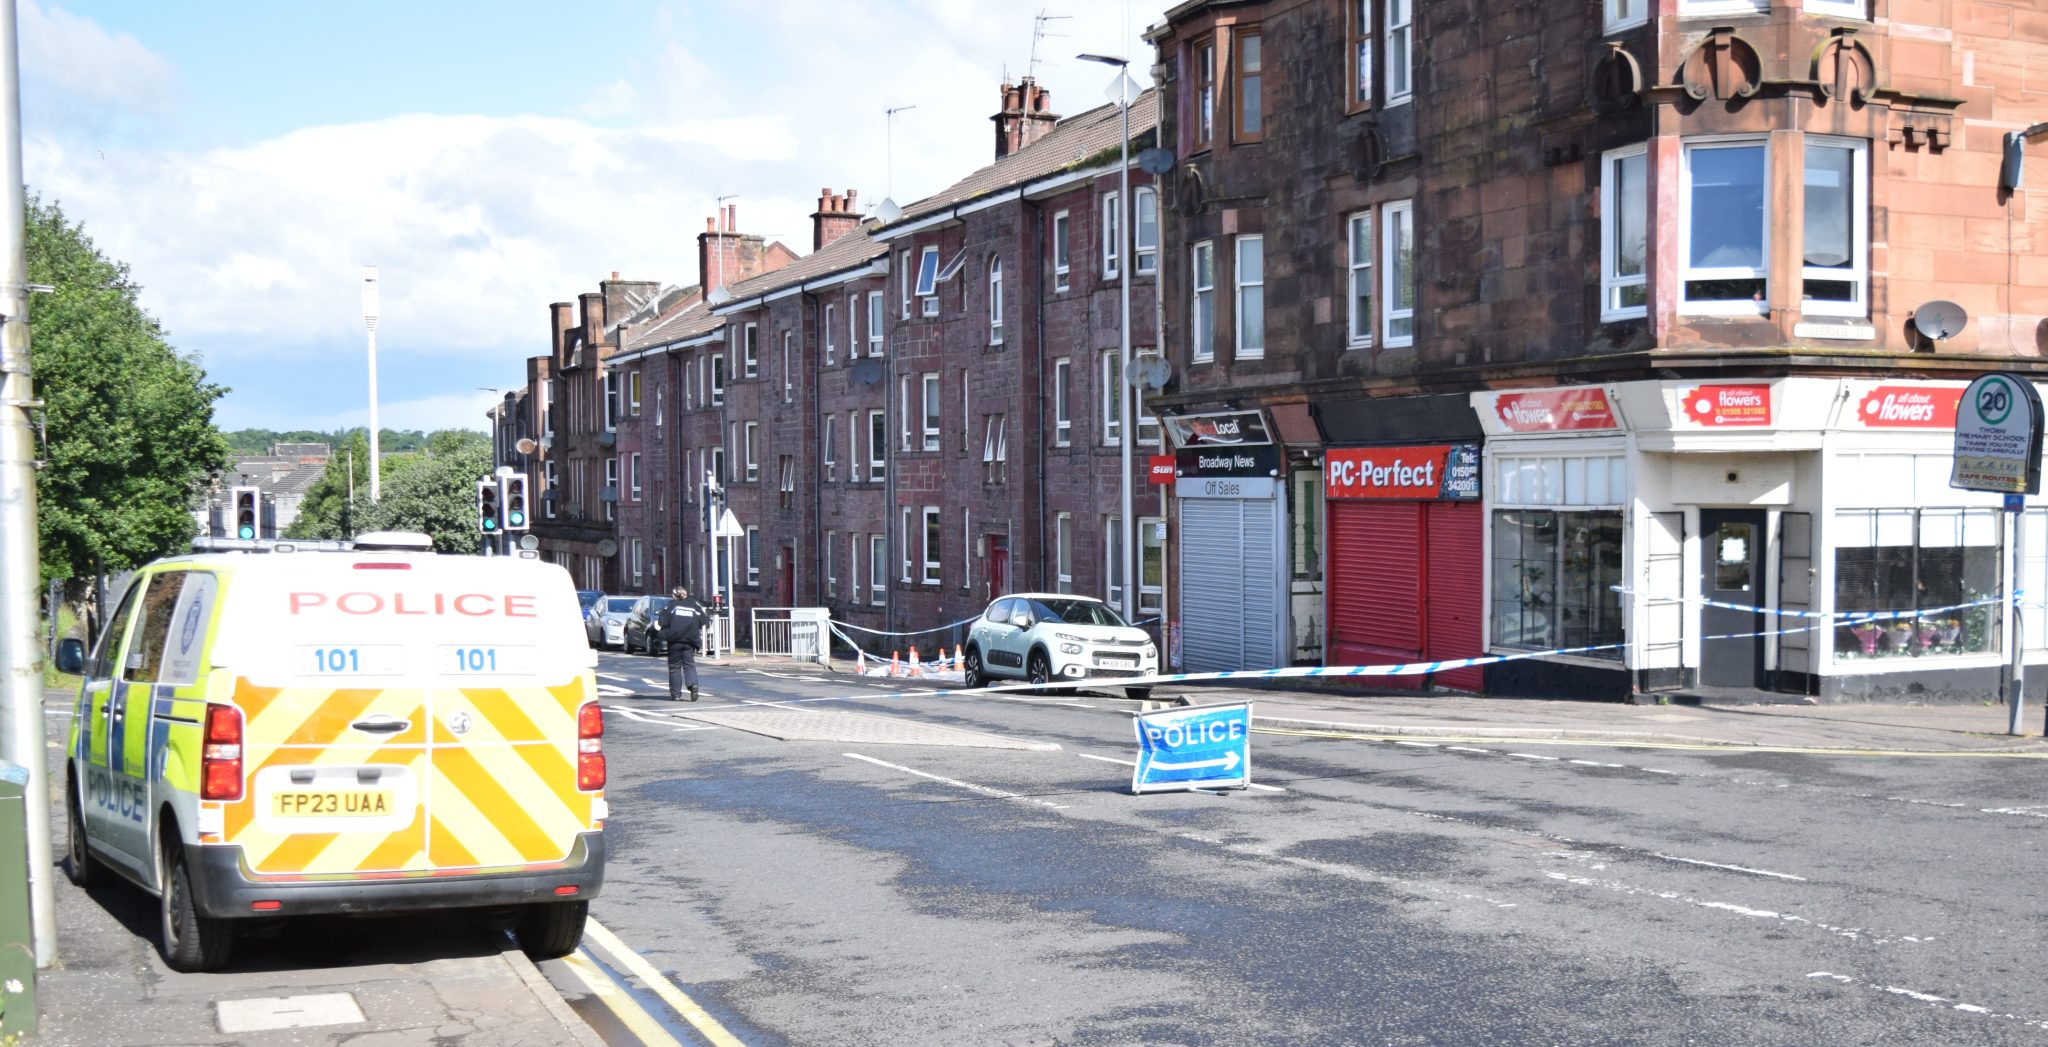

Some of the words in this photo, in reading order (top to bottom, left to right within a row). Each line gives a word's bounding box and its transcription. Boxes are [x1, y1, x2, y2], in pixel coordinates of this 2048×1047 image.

[1719, 390, 1761, 406] flowers
[1897, 392, 1908, 403] all
[1909, 393, 1931, 404] about
[1981, 391, 2007, 412] 20
[1879, 394, 1934, 421] flowers
[1979, 426, 2007, 434] THORN
[1993, 434, 2026, 443] SCHOOL
[1986, 447, 2025, 455] CAREFULLY
[1199, 456, 1233, 471] Broadway
[1234, 455, 1255, 468] News
[1330, 459, 1434, 487] PC-Perfect
[1959, 472, 1980, 481] SAFE
[1982, 473, 2017, 483] ROUTES
[1205, 481, 1217, 495] Off
[1218, 481, 1240, 495] Sales
[1447, 479, 1475, 491] 342001
[289, 592, 538, 617] POLICE
[315, 649, 358, 672] 101
[456, 649, 496, 671] 101
[1148, 719, 1242, 748] POLICE
[88, 770, 143, 823] POLICE
[281, 793, 338, 813] FP23
[345, 793, 386, 812] UAA
